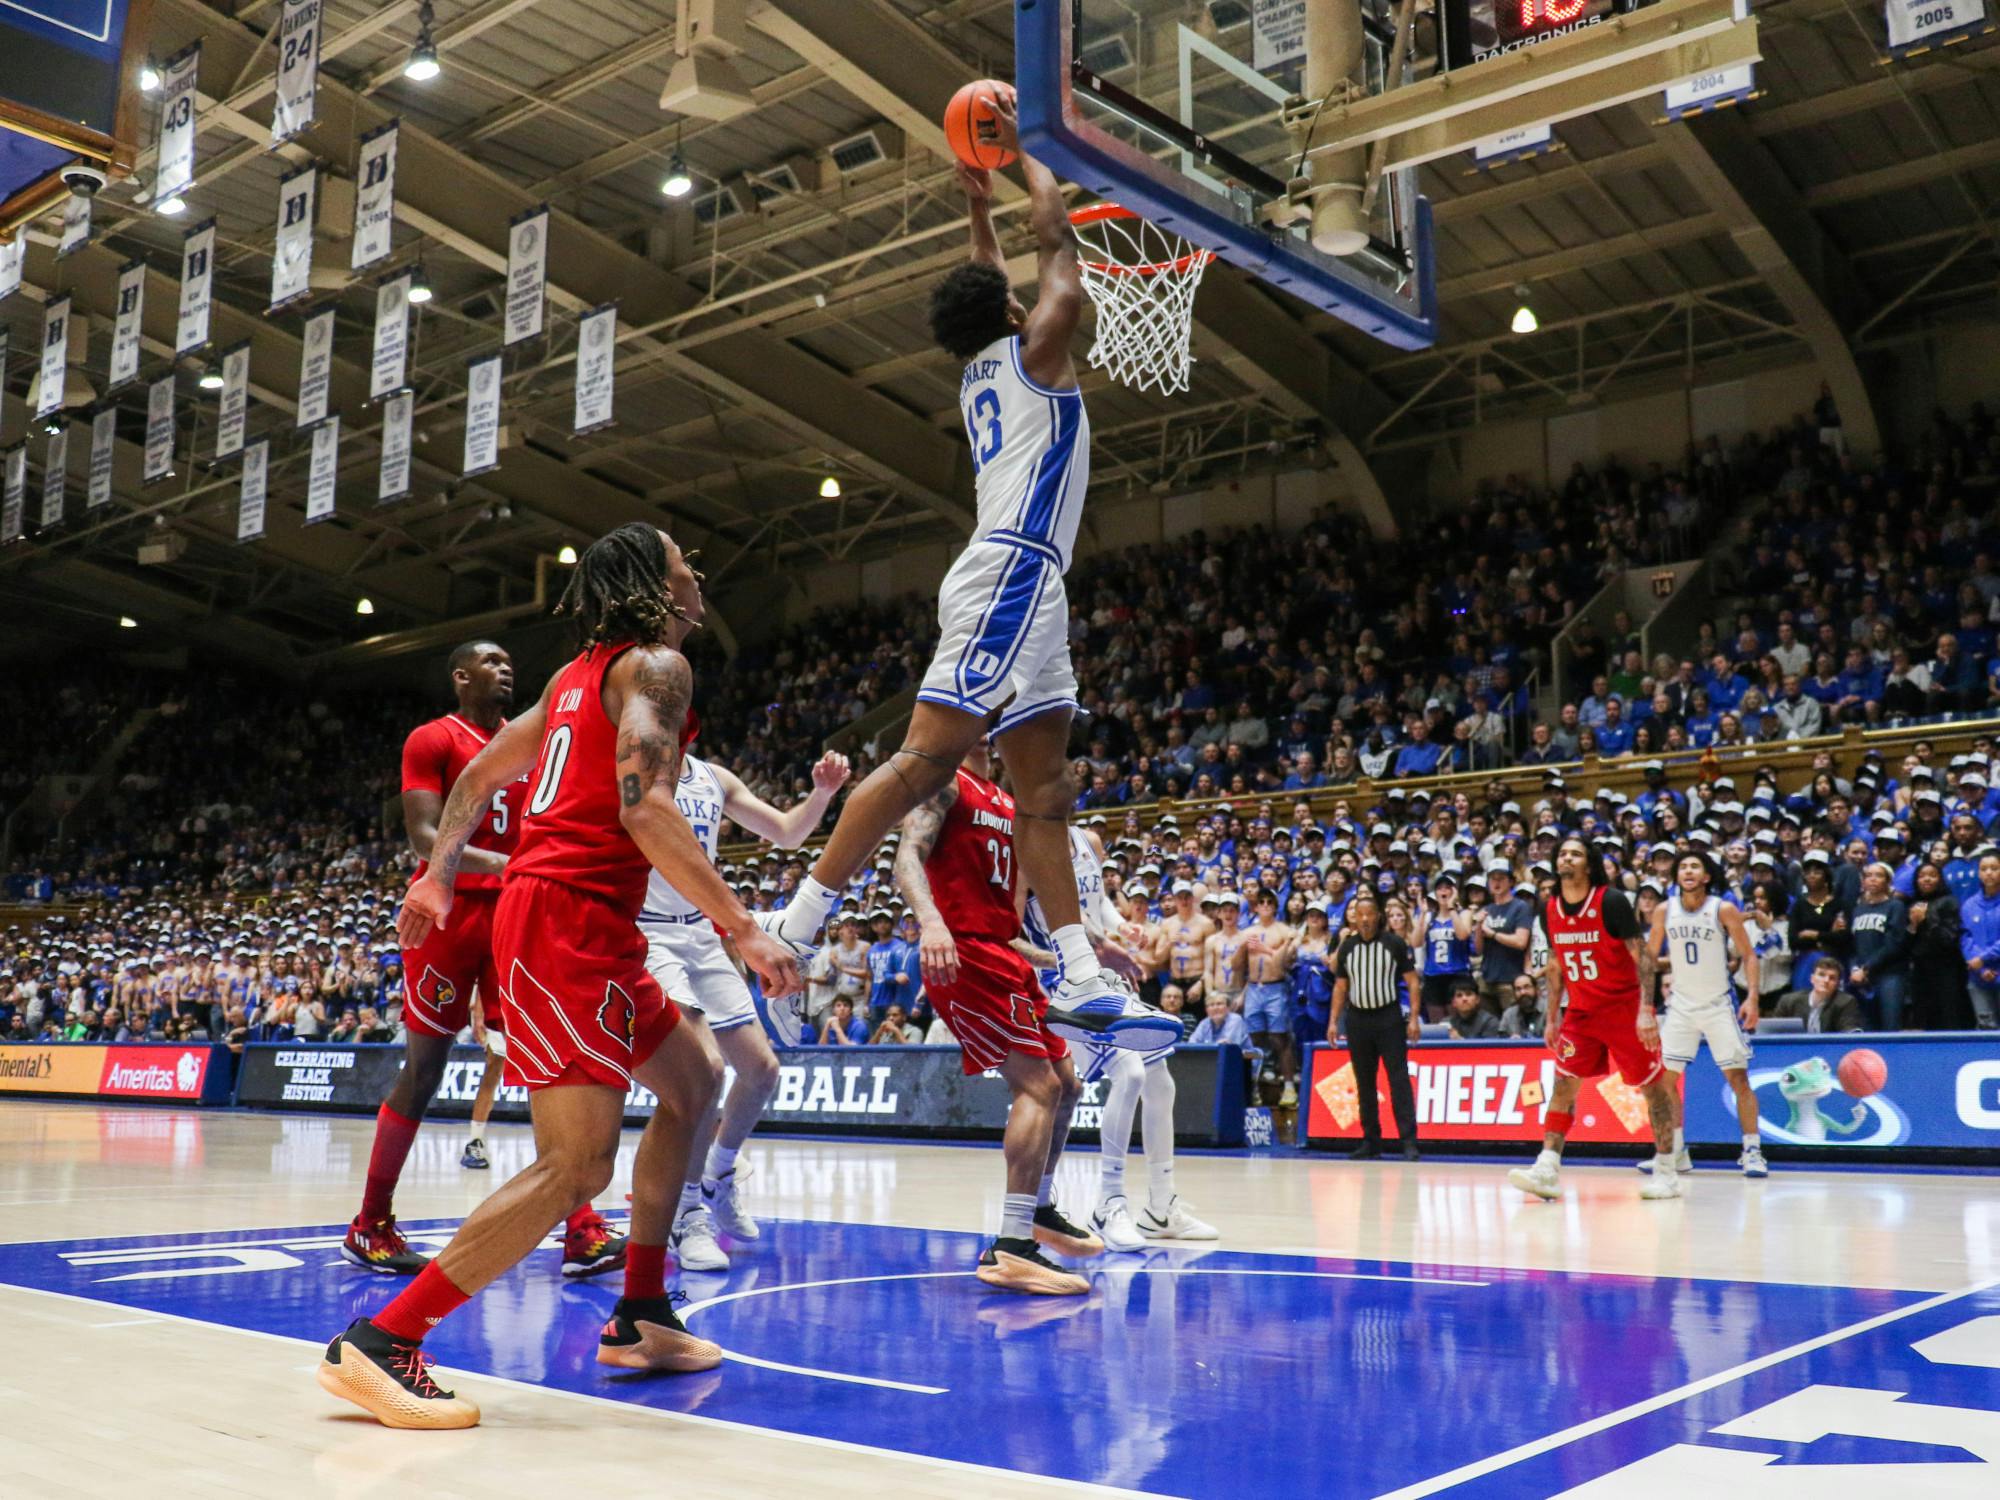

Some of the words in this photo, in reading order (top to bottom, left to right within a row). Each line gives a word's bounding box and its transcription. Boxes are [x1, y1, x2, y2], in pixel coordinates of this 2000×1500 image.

[1915, 6, 1953, 29] 2005
[284, 28, 312, 73] 24
[1691, 73, 1725, 93] 2004
[164, 96, 190, 133] 43
[968, 388, 1003, 475] 13
[529, 724, 573, 816] 0
[492, 789, 509, 836] 5
[676, 798, 720, 825] UKE
[1079, 874, 1100, 895] KE
[1668, 926, 1716, 942] DUKE
[1851, 913, 1887, 934] DUKE
[1435, 940, 1449, 963] 2
[1684, 941, 1699, 965] 0
[1563, 950, 1599, 982] 55
[274, 1051, 355, 1069] CELEBRATING
[106, 1063, 174, 1091] Ameritas
[290, 1068, 331, 1085] BLACK
[437, 1061, 486, 1101] KE
[282, 1085, 335, 1102] HISTORY
